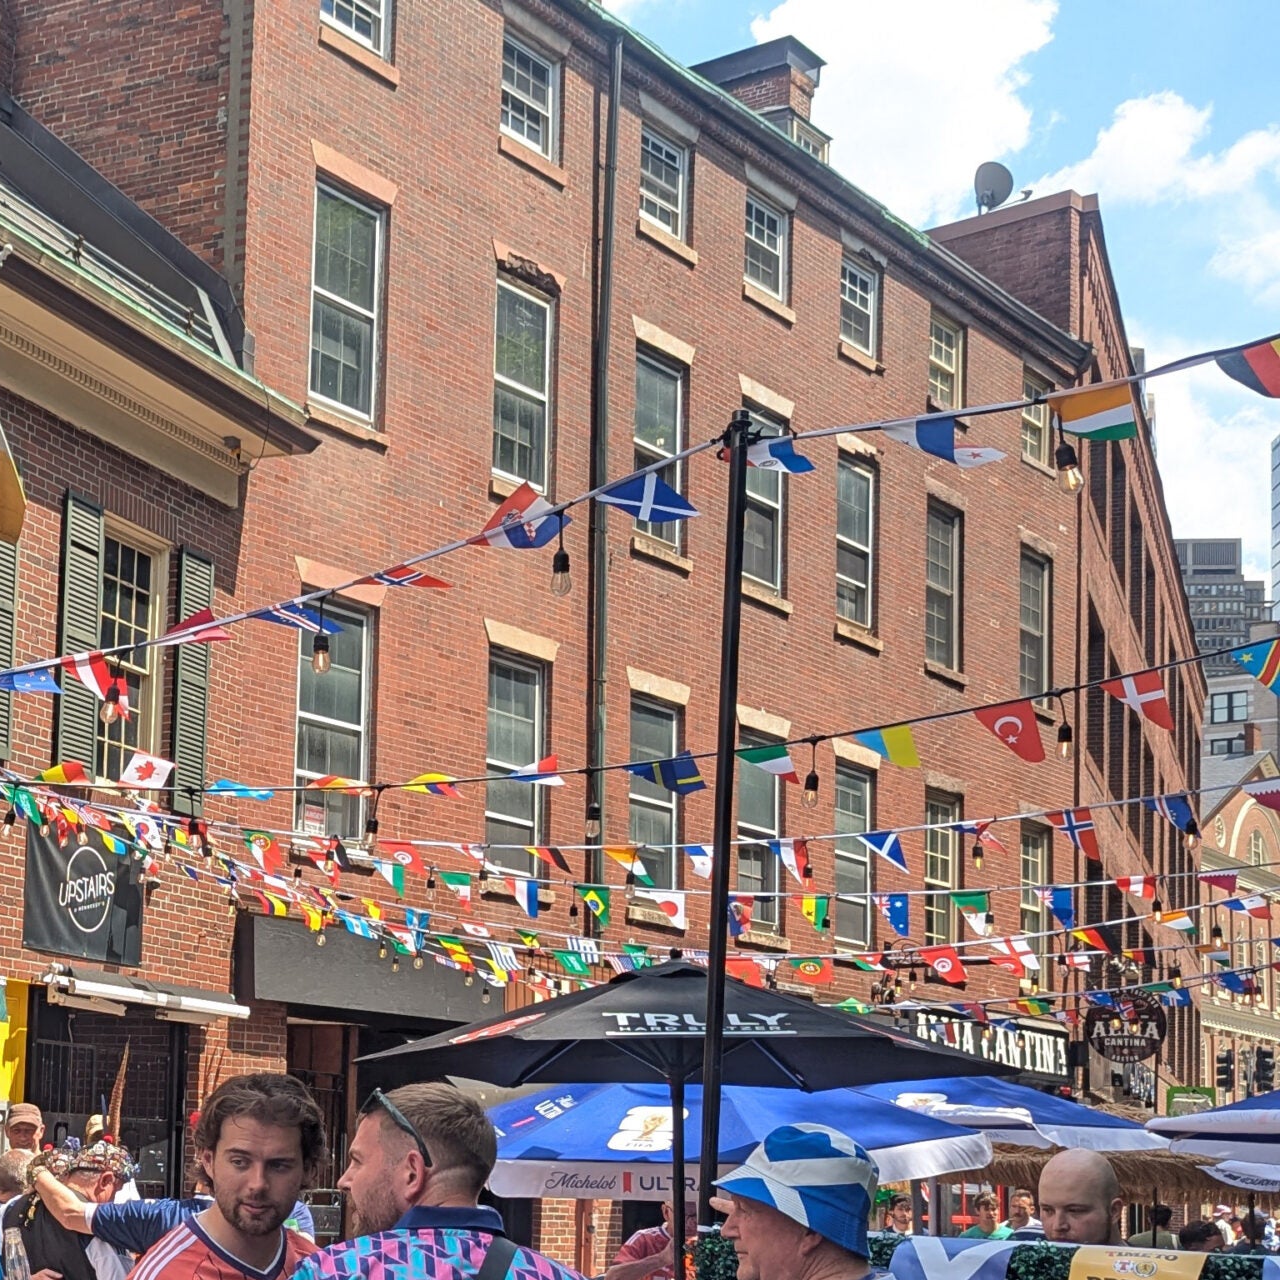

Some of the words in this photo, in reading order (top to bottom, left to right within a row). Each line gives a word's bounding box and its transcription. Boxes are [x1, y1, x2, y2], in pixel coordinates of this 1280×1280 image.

[59, 872, 115, 906] UPSTAIRS
[1104, 1037, 1146, 1047] CANTINA
[545, 1171, 617, 1190] Michelob
[1105, 1251, 1149, 1259] TIME
